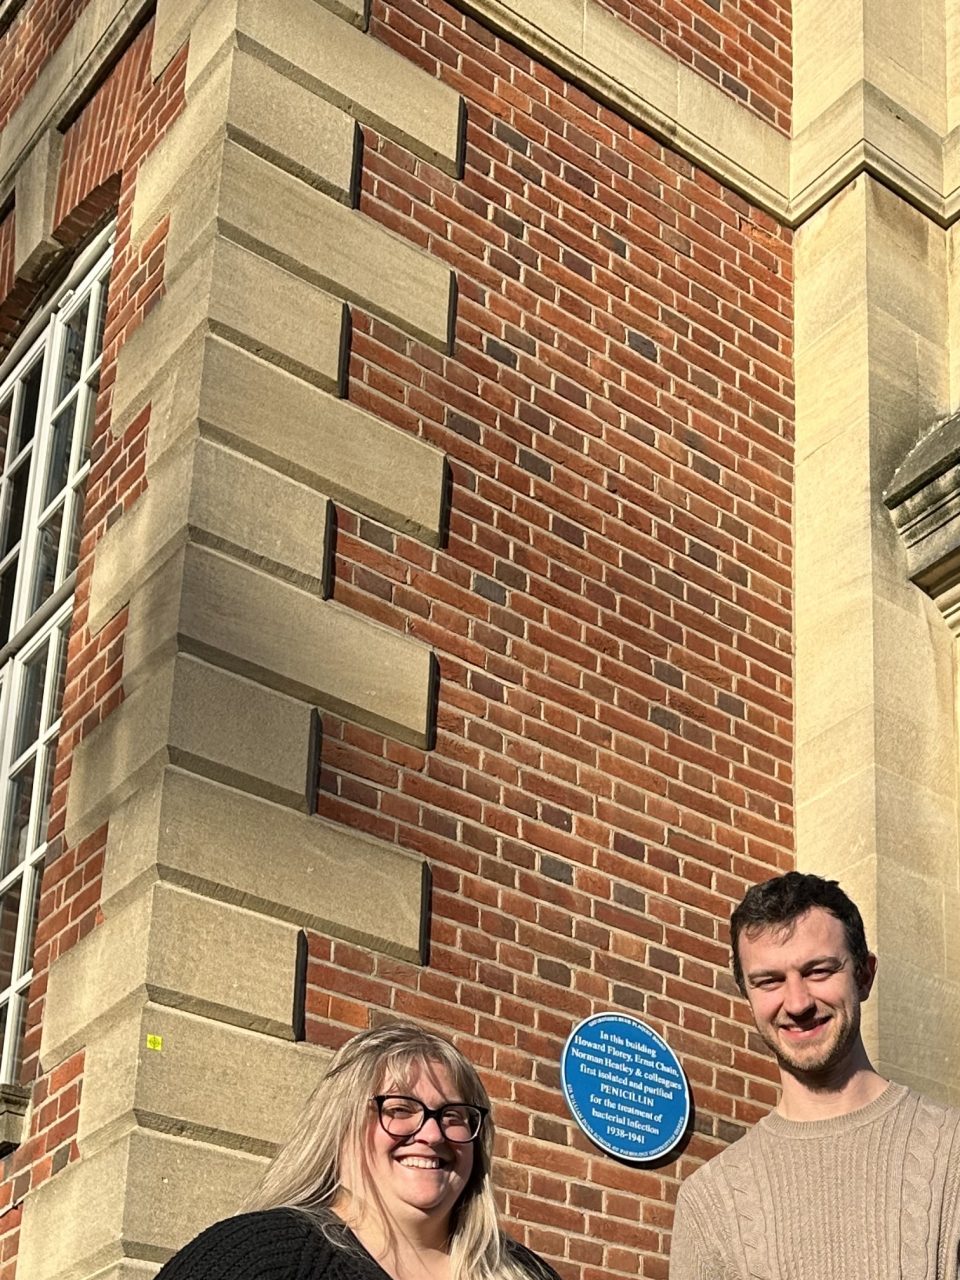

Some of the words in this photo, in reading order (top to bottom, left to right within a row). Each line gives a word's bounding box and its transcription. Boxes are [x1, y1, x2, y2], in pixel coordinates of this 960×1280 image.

[574, 1034, 606, 1053] Howard
[635, 1053, 654, 1068] Ernst
[600, 1030, 609, 1040] In
[610, 1034, 624, 1045] this
[625, 1038, 657, 1058] building
[571, 1047, 603, 1065] Norman
[635, 1068, 643, 1077] &
[643, 1070, 682, 1090] colleagues
[580, 1063, 597, 1076] first
[598, 1069, 627, 1086] isolated
[628, 1079, 643, 1091] and
[590, 1094, 602, 1105] for
[604, 1097, 617, 1109] the
[617, 1101, 653, 1120] treatment
[653, 1113, 663, 1123] of
[600, 1083, 654, 1107] PENICILLIN
[591, 1108, 626, 1125] bacterial
[627, 1118, 659, 1135] infection
[607, 1125, 645, 1144] 1938-1941
